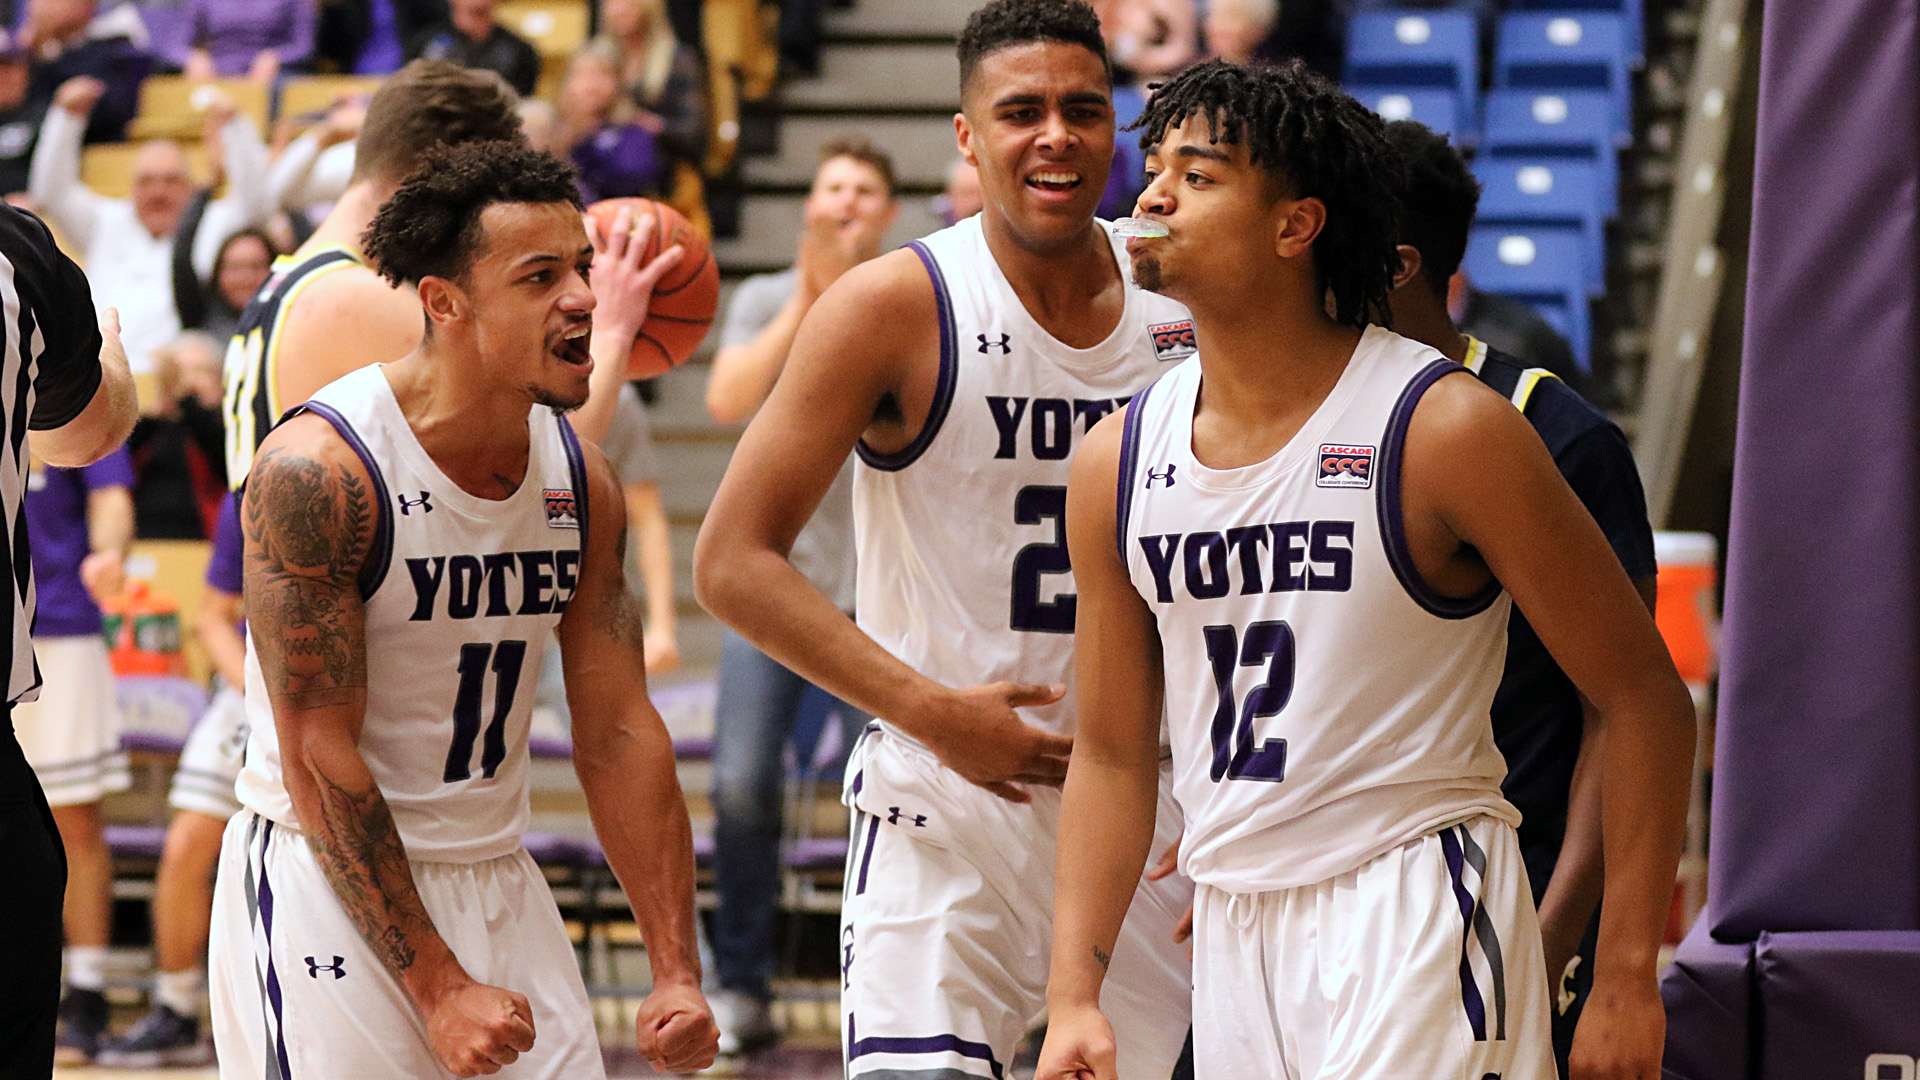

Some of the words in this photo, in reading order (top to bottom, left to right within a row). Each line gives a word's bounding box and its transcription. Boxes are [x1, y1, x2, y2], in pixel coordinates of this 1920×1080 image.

[1150, 322, 1191, 332] CASCADE
[1156, 331, 1195, 347] CCC
[985, 396, 1133, 460] YOT
[1322, 446, 1372, 455] CASCADE
[1322, 457, 1370, 474] CCC
[405, 550, 580, 621] YOTES
[1138, 520, 1355, 603] YOTES
[443, 639, 527, 784] 11
[1203, 620, 1296, 783] 12
